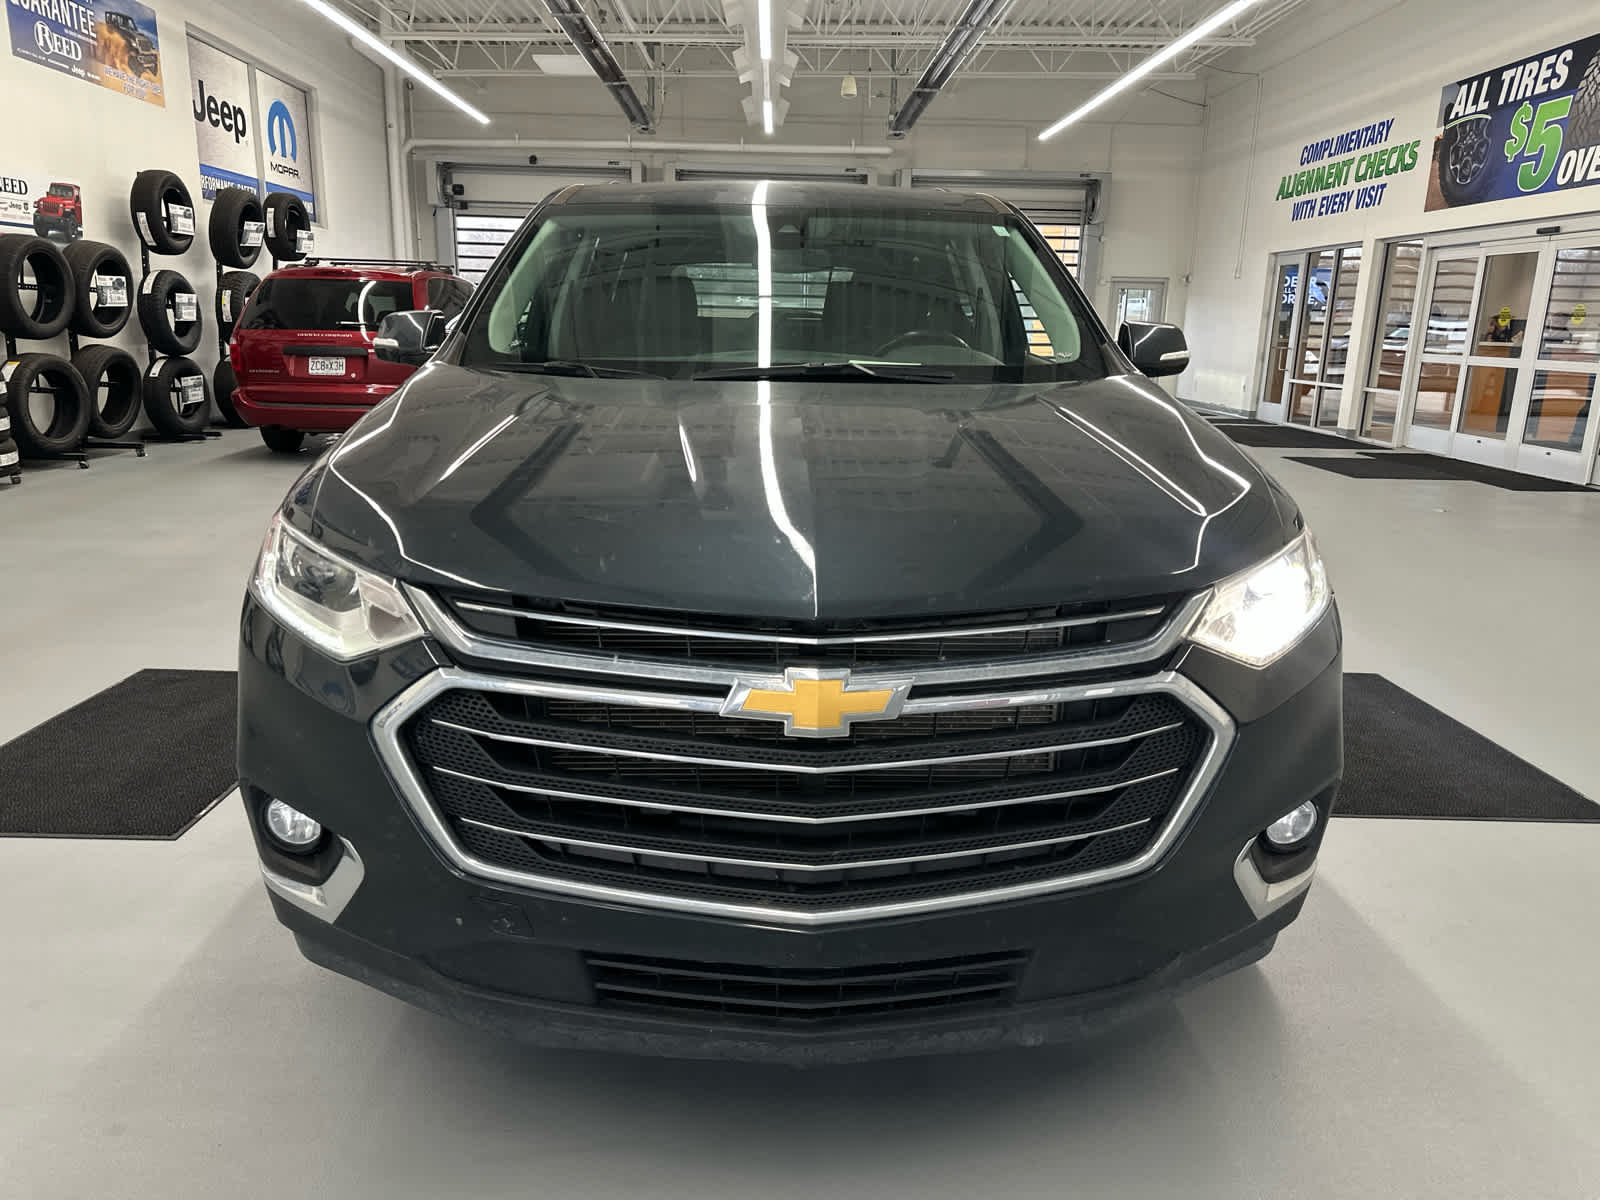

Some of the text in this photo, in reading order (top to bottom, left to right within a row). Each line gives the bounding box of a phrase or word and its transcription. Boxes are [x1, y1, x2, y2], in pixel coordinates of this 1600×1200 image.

[34, 20, 82, 61] REED
[1449, 49, 1574, 119] ALL TIRES
[193, 79, 247, 144] Jeep
[1300, 117, 1395, 166] COMPLIMENTARY
[1504, 94, 1574, 192] $5
[0, 176, 28, 195] EED
[270, 161, 299, 178] MOPAR
[1275, 139, 1421, 201] ALIGNMENT CHECKS
[1291, 182, 1388, 222] WITH EVERY VISIT
